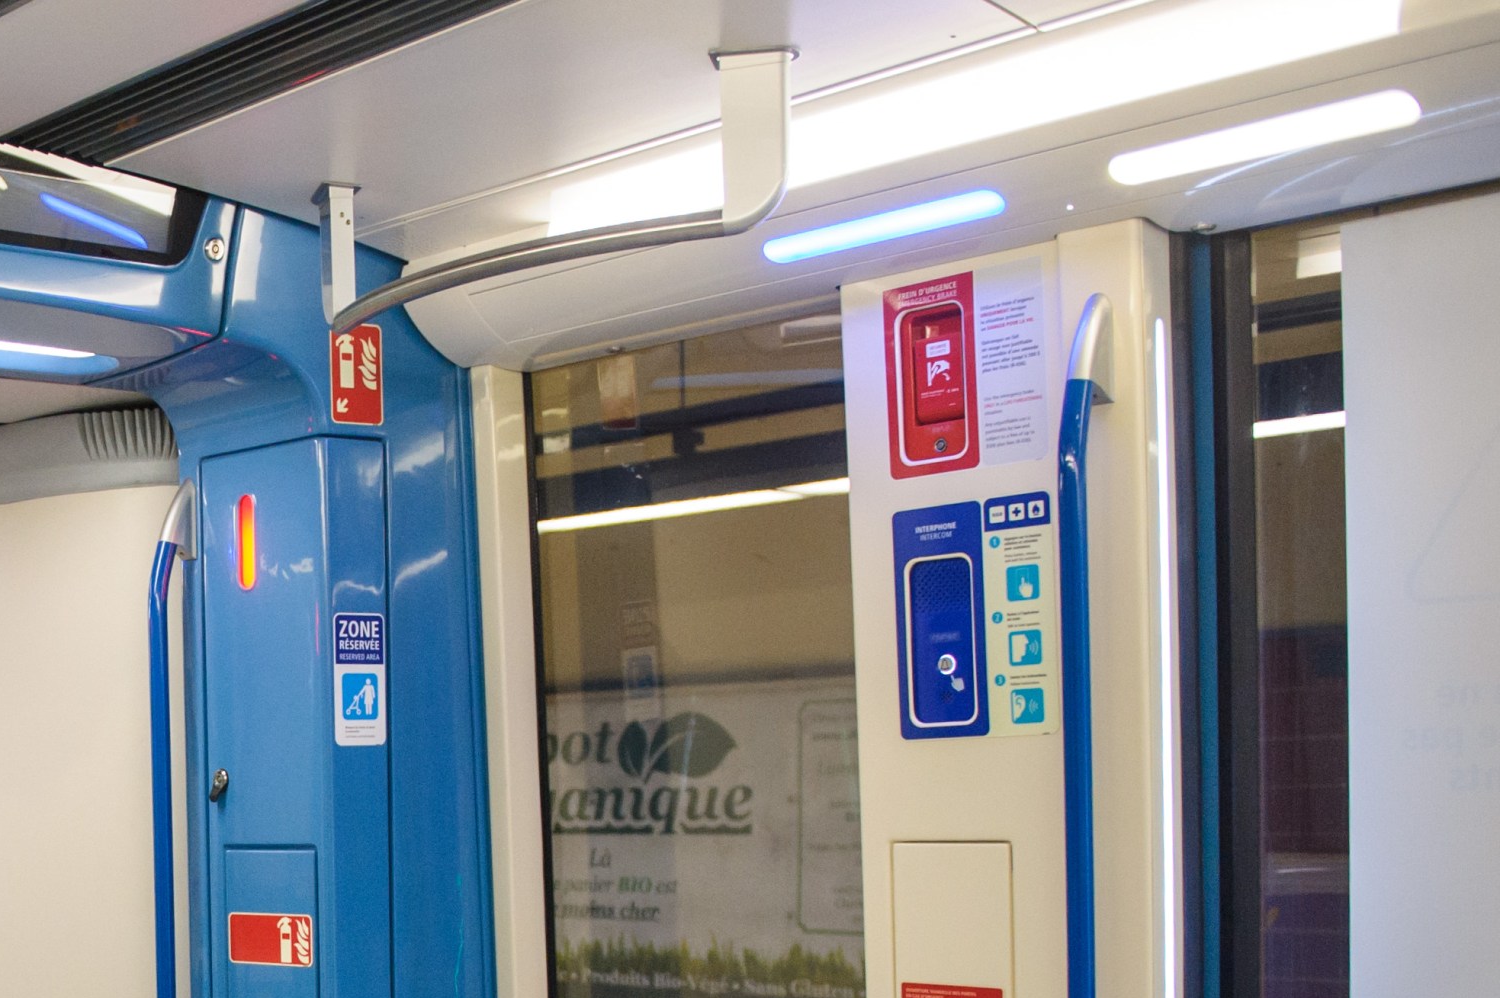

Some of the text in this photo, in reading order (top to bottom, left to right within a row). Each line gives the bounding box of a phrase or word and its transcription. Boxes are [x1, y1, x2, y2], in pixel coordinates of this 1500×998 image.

[914, 521, 957, 534] INTERPHONE
[338, 620, 380, 638] ZONE
[339, 638, 380, 651] RÉSERVÉE
[339, 652, 380, 661] RESERVED AREA
[618, 875, 653, 894] BIO
[619, 901, 660, 920] cher
